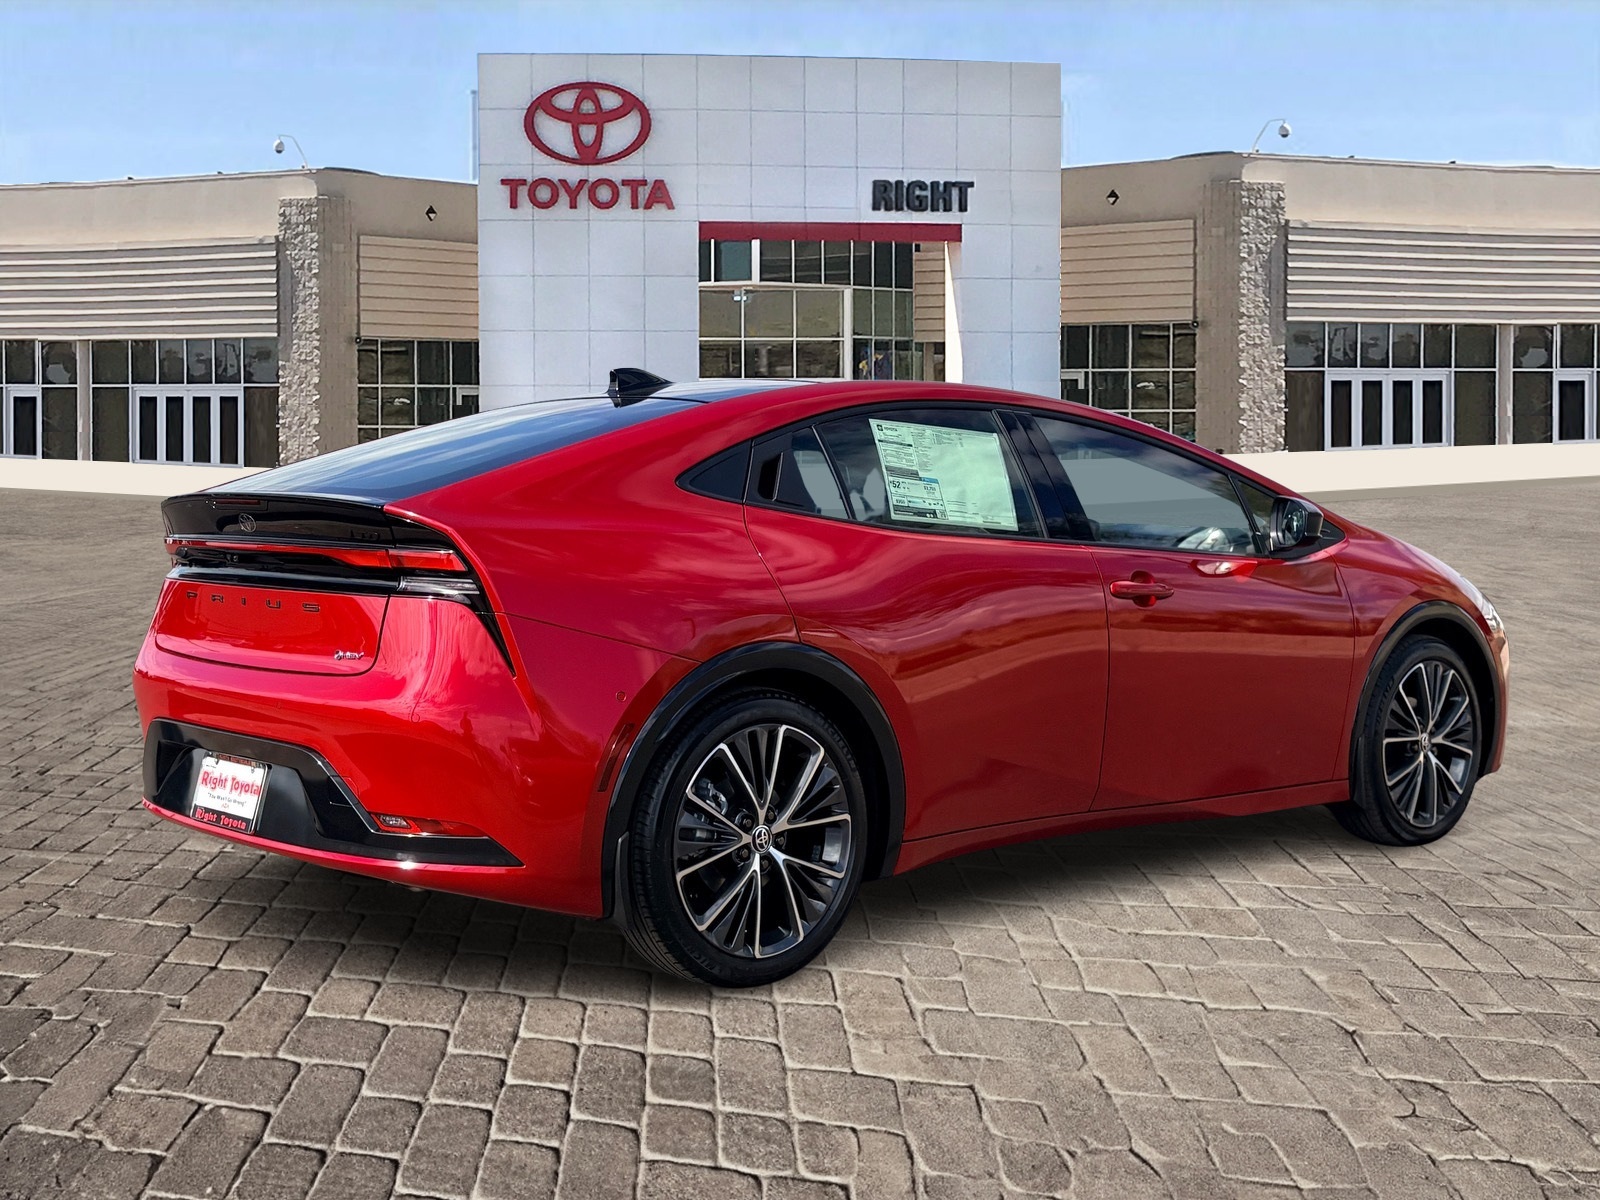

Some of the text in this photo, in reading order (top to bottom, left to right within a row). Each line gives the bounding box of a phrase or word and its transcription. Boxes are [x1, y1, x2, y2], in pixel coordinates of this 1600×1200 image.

[500, 178, 675, 210] TOYOTA
[871, 179, 975, 212] RIGHT
[186, 590, 321, 613] PRIUS
[201, 770, 261, 796] Right Toyota
[195, 807, 247, 830] Right Toyota
